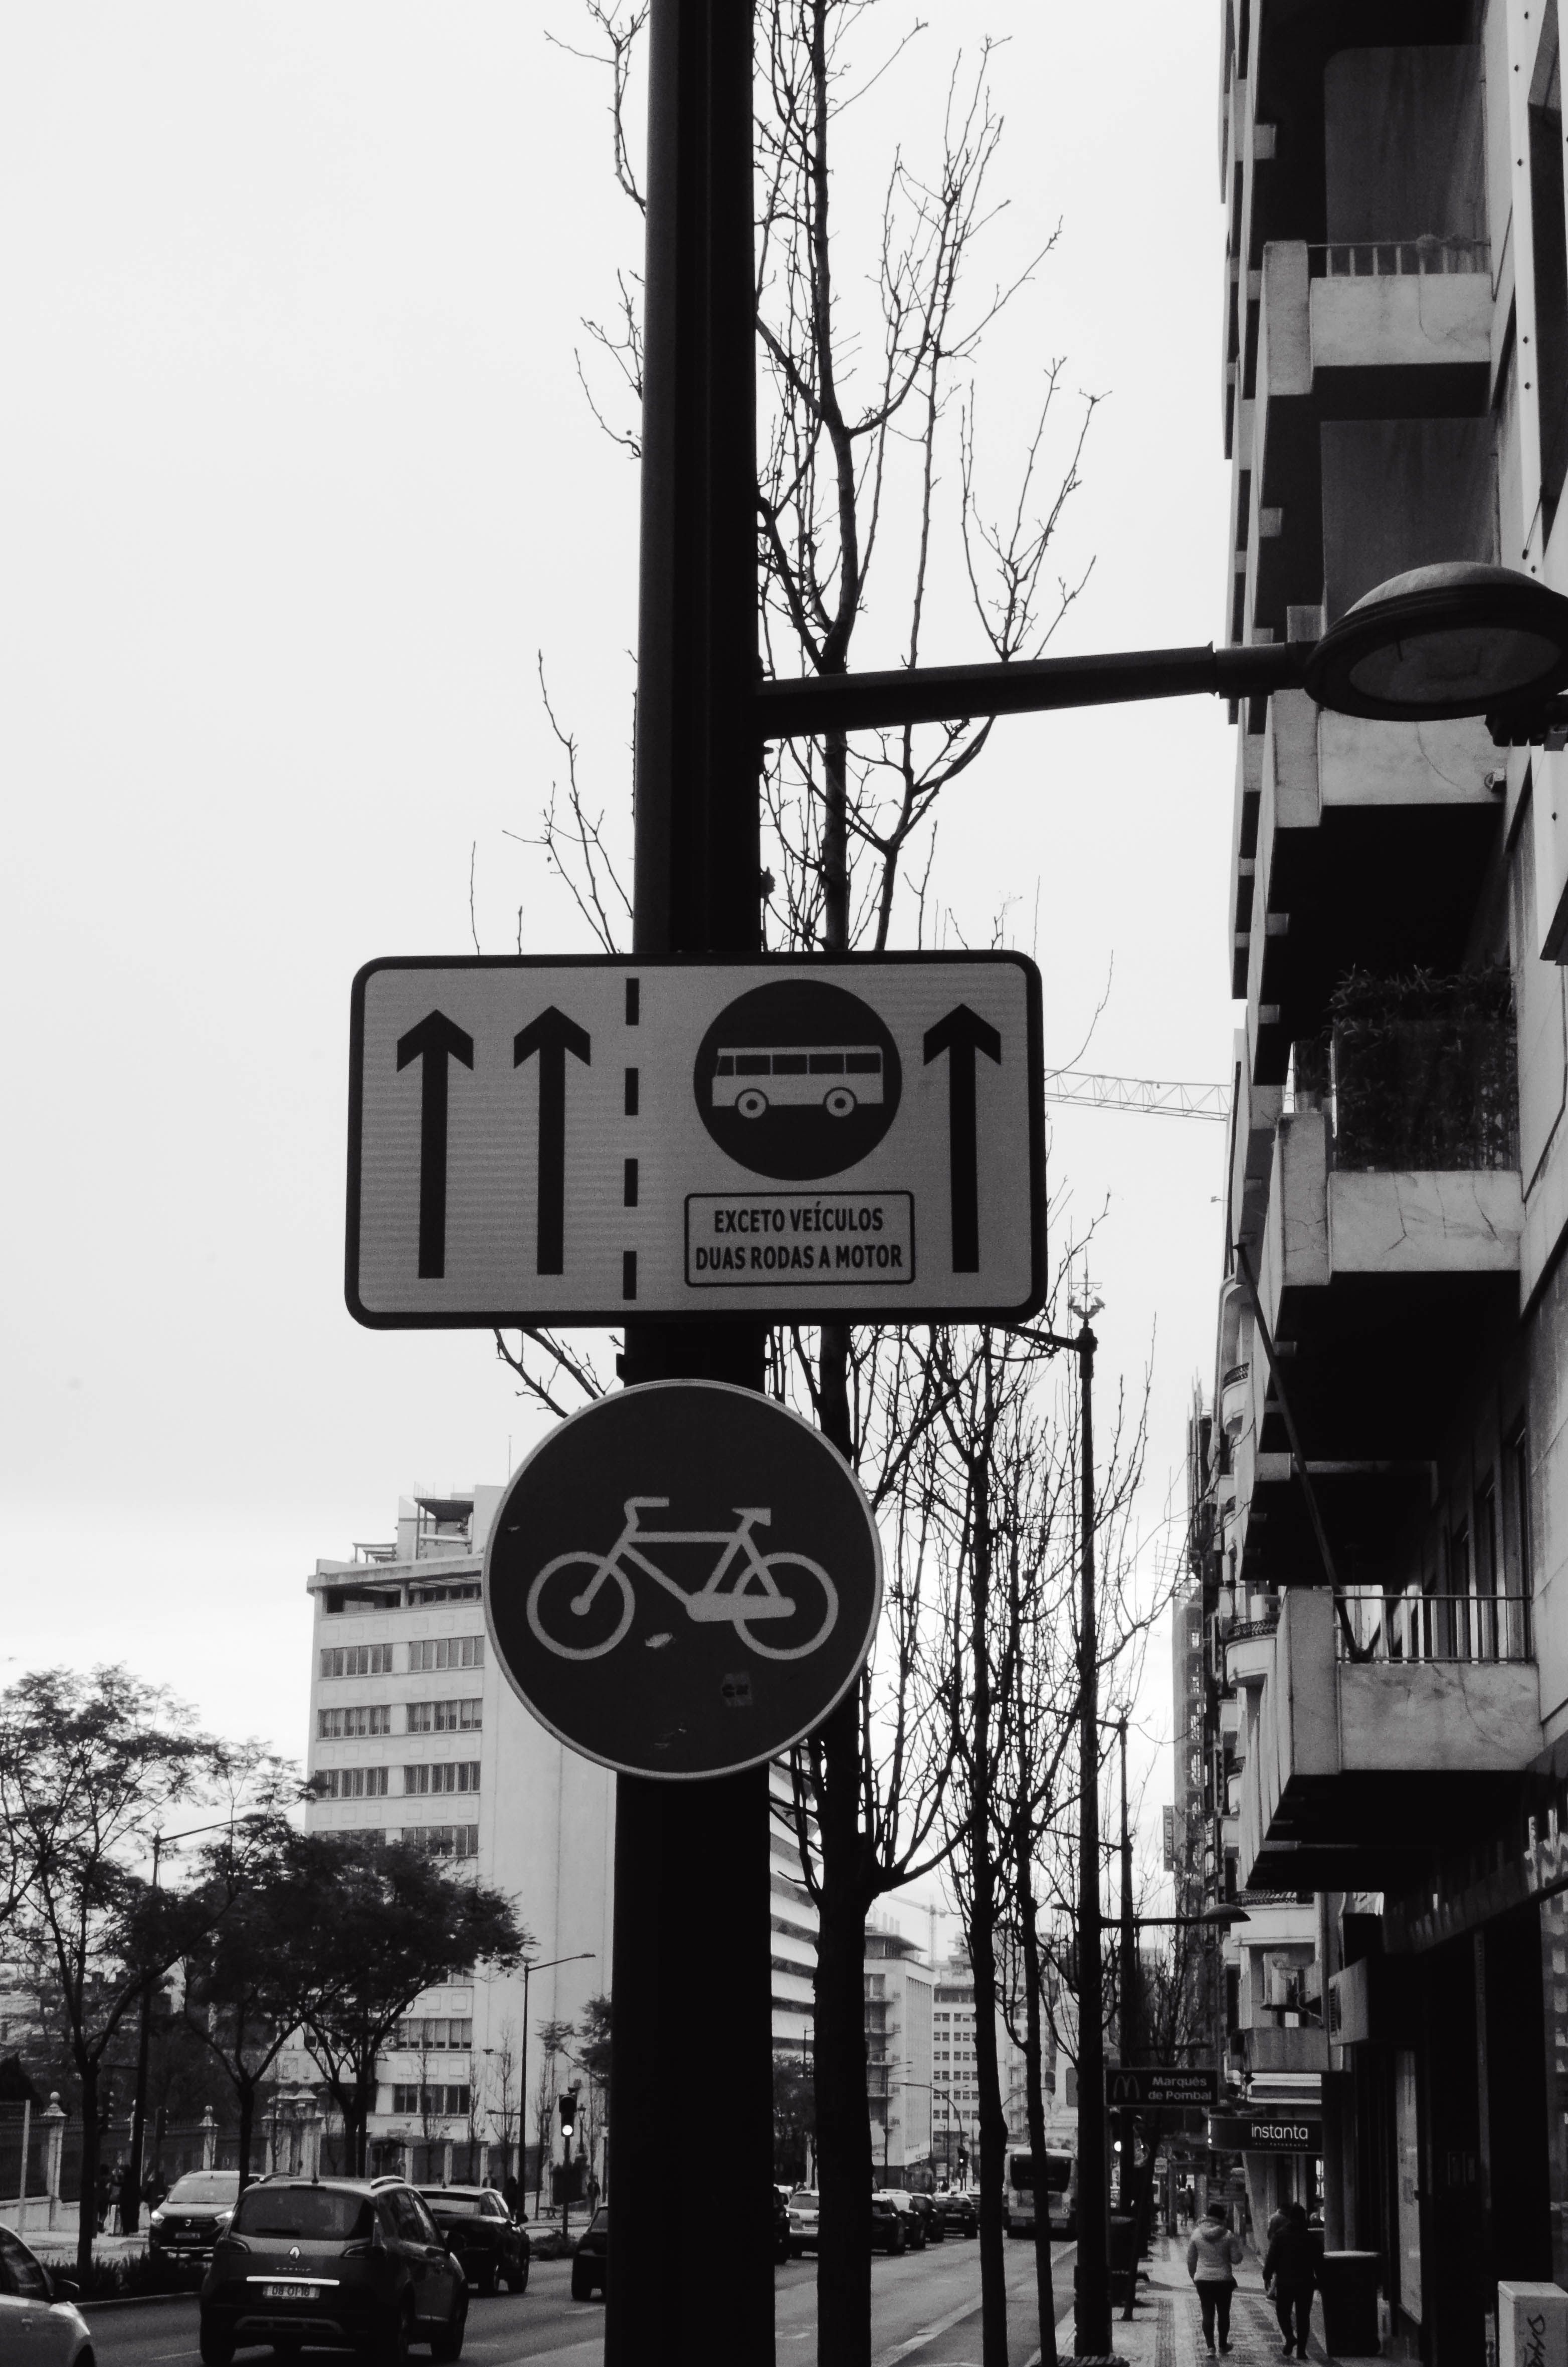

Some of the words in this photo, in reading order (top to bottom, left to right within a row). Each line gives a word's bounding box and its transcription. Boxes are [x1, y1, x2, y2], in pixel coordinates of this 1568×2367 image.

[714, 1209, 785, 1233] EXCETO
[790, 1200, 883, 1232] VEÍCULOS
[696, 1247, 745, 1270] DUAS
[751, 1246, 814, 1270] RODAS
[819, 1246, 831, 1269] A
[836, 1245, 903, 1269] MOTOR
[1152, 2076, 1208, 2089] Marquês
[1147, 2090, 1163, 2100] de
[1165, 2090, 1212, 2100] Pombal
[1251, 2122, 1308, 2139] instanta
